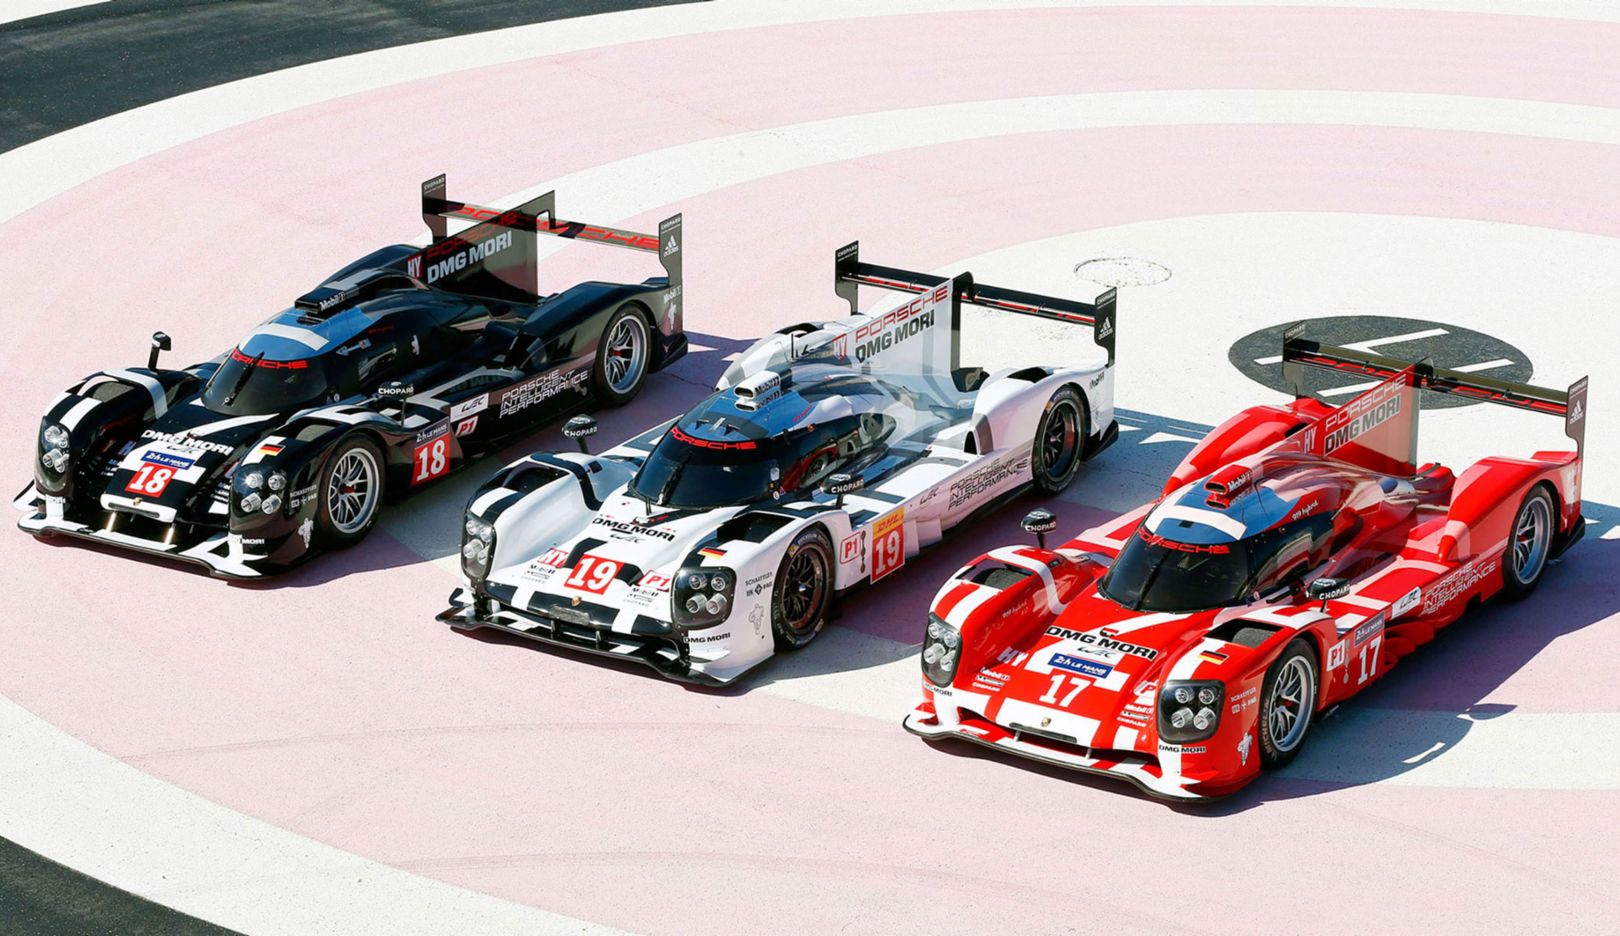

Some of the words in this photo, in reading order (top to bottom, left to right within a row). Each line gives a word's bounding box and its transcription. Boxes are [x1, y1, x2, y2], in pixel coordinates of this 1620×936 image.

[408, 255, 421, 279] HY
[427, 251, 466, 284] DMG
[469, 231, 512, 265] MORI
[856, 285, 947, 343] PORSCHE
[856, 331, 892, 363] DMG
[895, 309, 934, 344] MORI
[500, 370, 575, 410] INTELLIGENT
[502, 369, 560, 401] PORSCHE
[1326, 374, 1406, 432] PORSCHE
[460, 420, 475, 433] P1
[671, 426, 757, 450] PORSCHE
[1304, 427, 1316, 453] HY
[1325, 419, 1361, 454] DMG
[1362, 395, 1400, 432] MORI
[141, 429, 185, 445] DMG
[183, 439, 234, 456] MORI
[416, 439, 446, 482] 18
[951, 457, 1001, 491] PORSCHE
[128, 465, 173, 494] 18
[831, 479, 864, 493] CHOPARD
[950, 458, 1015, 501] INTELLIGENT
[592, 517, 630, 530] DMG
[631, 526, 676, 542] MORI
[845, 538, 858, 559] P1
[876, 530, 900, 576] 19
[568, 557, 618, 591] 19
[646, 575, 671, 587] P1
[1425, 561, 1473, 600] PORSCHE
[683, 636, 706, 644] DMG
[707, 632, 731, 643] MORI
[1046, 626, 1097, 644] DMG
[1098, 638, 1157, 660] MORI
[1331, 642, 1345, 667] P1
[997, 646, 1029, 667] HY
[1358, 635, 1382, 685] 17
[1039, 673, 1091, 708] 17
[1158, 744, 1180, 753] DMG
